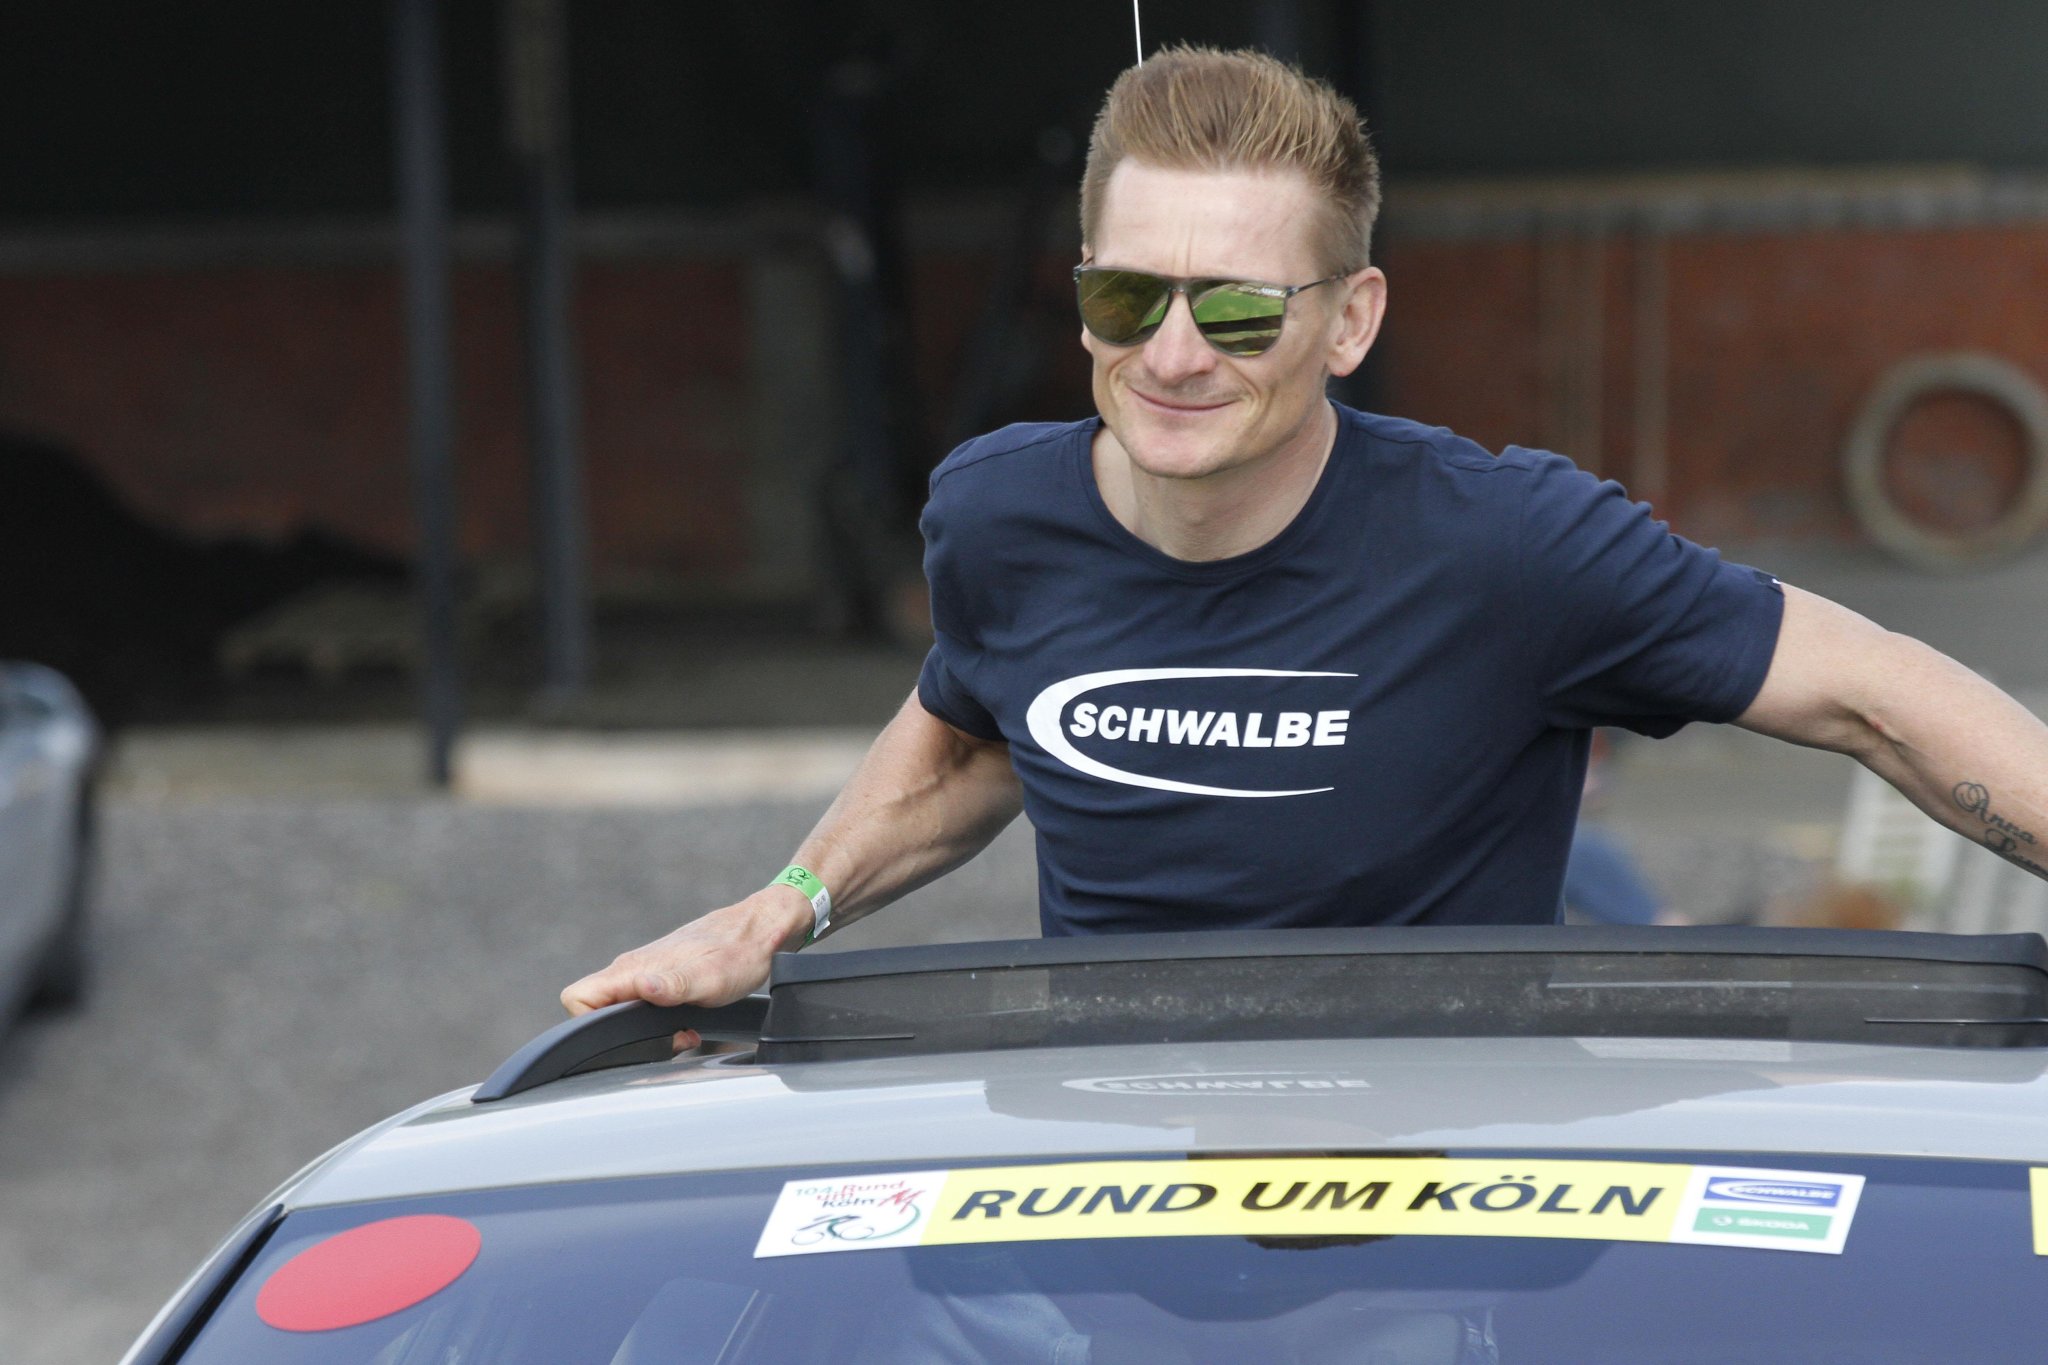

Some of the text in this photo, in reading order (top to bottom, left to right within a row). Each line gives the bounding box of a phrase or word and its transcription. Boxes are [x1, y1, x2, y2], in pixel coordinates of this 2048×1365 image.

[1069, 702, 1350, 747] SCHWALBE
[841, 1180, 905, 1194] Rund
[951, 1175, 1665, 1220] RUND UM KÖLN
